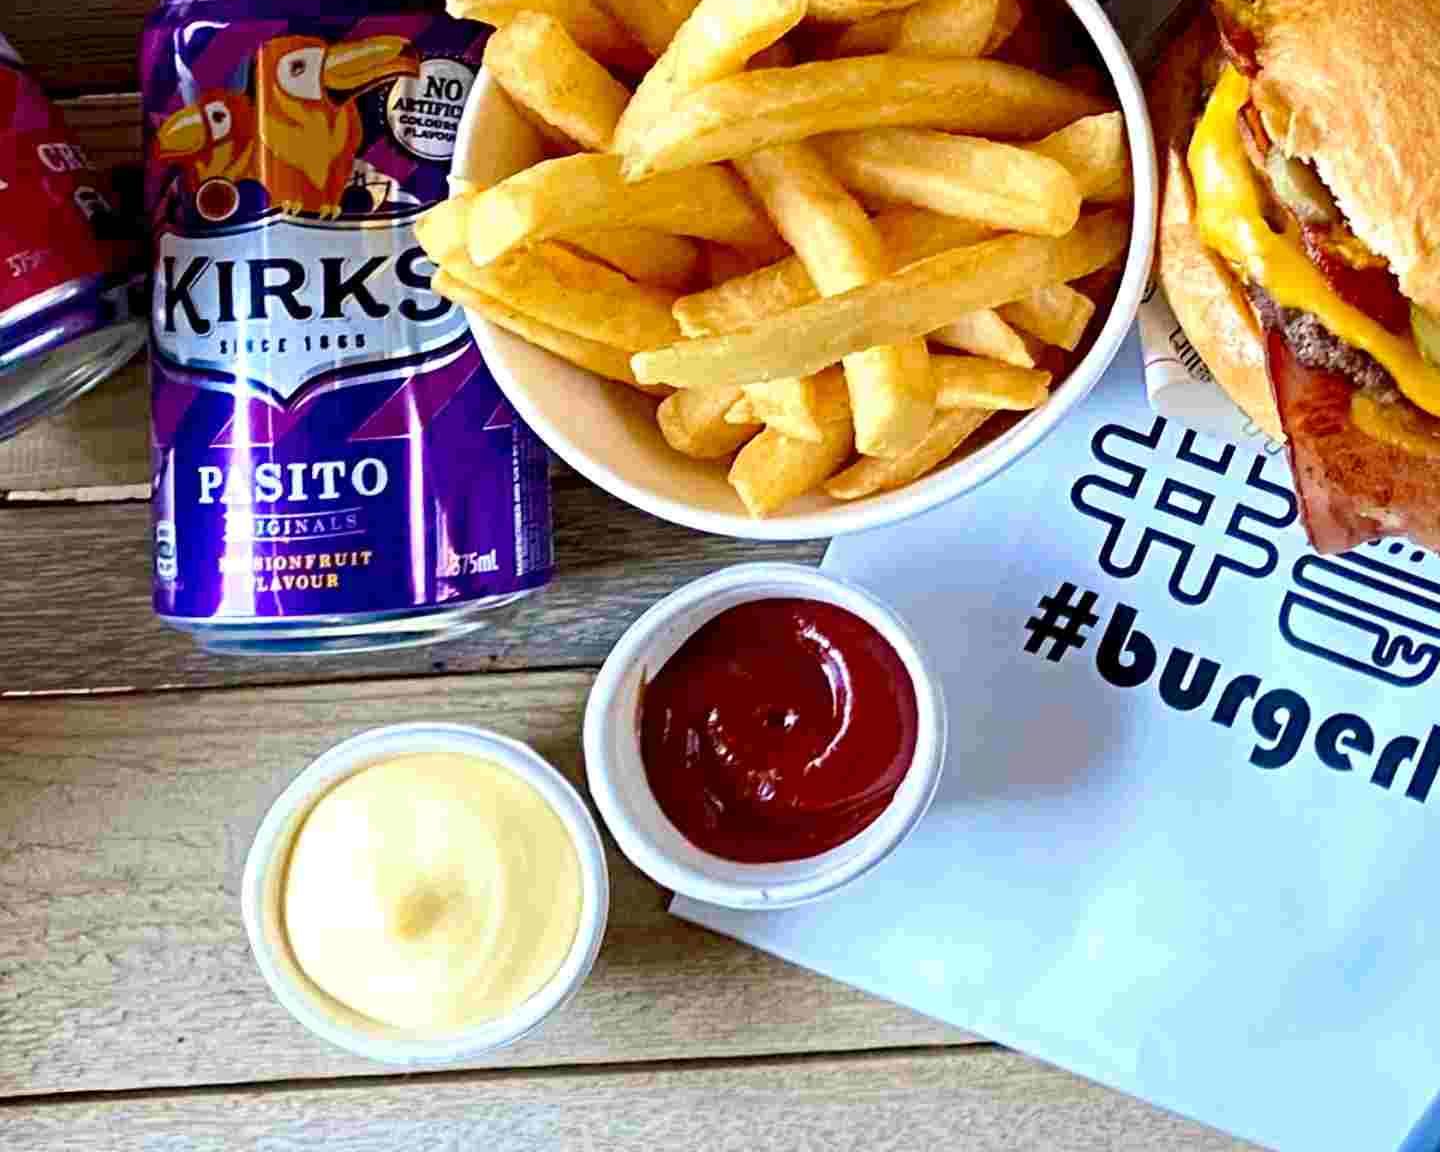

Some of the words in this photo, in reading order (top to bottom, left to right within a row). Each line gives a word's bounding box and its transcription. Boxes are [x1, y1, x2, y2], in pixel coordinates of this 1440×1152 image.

[424, 76, 463, 101] NO
[392, 97, 463, 119] ARTIFIC
[404, 127, 457, 143] FLAVOU
[163, 245, 453, 335] KIRKS
[198, 457, 388, 504] PASITO
[228, 513, 358, 536] IGINALS
[219, 551, 373, 574] SIONFRUIT
[248, 573, 339, 592] LAVOUR
